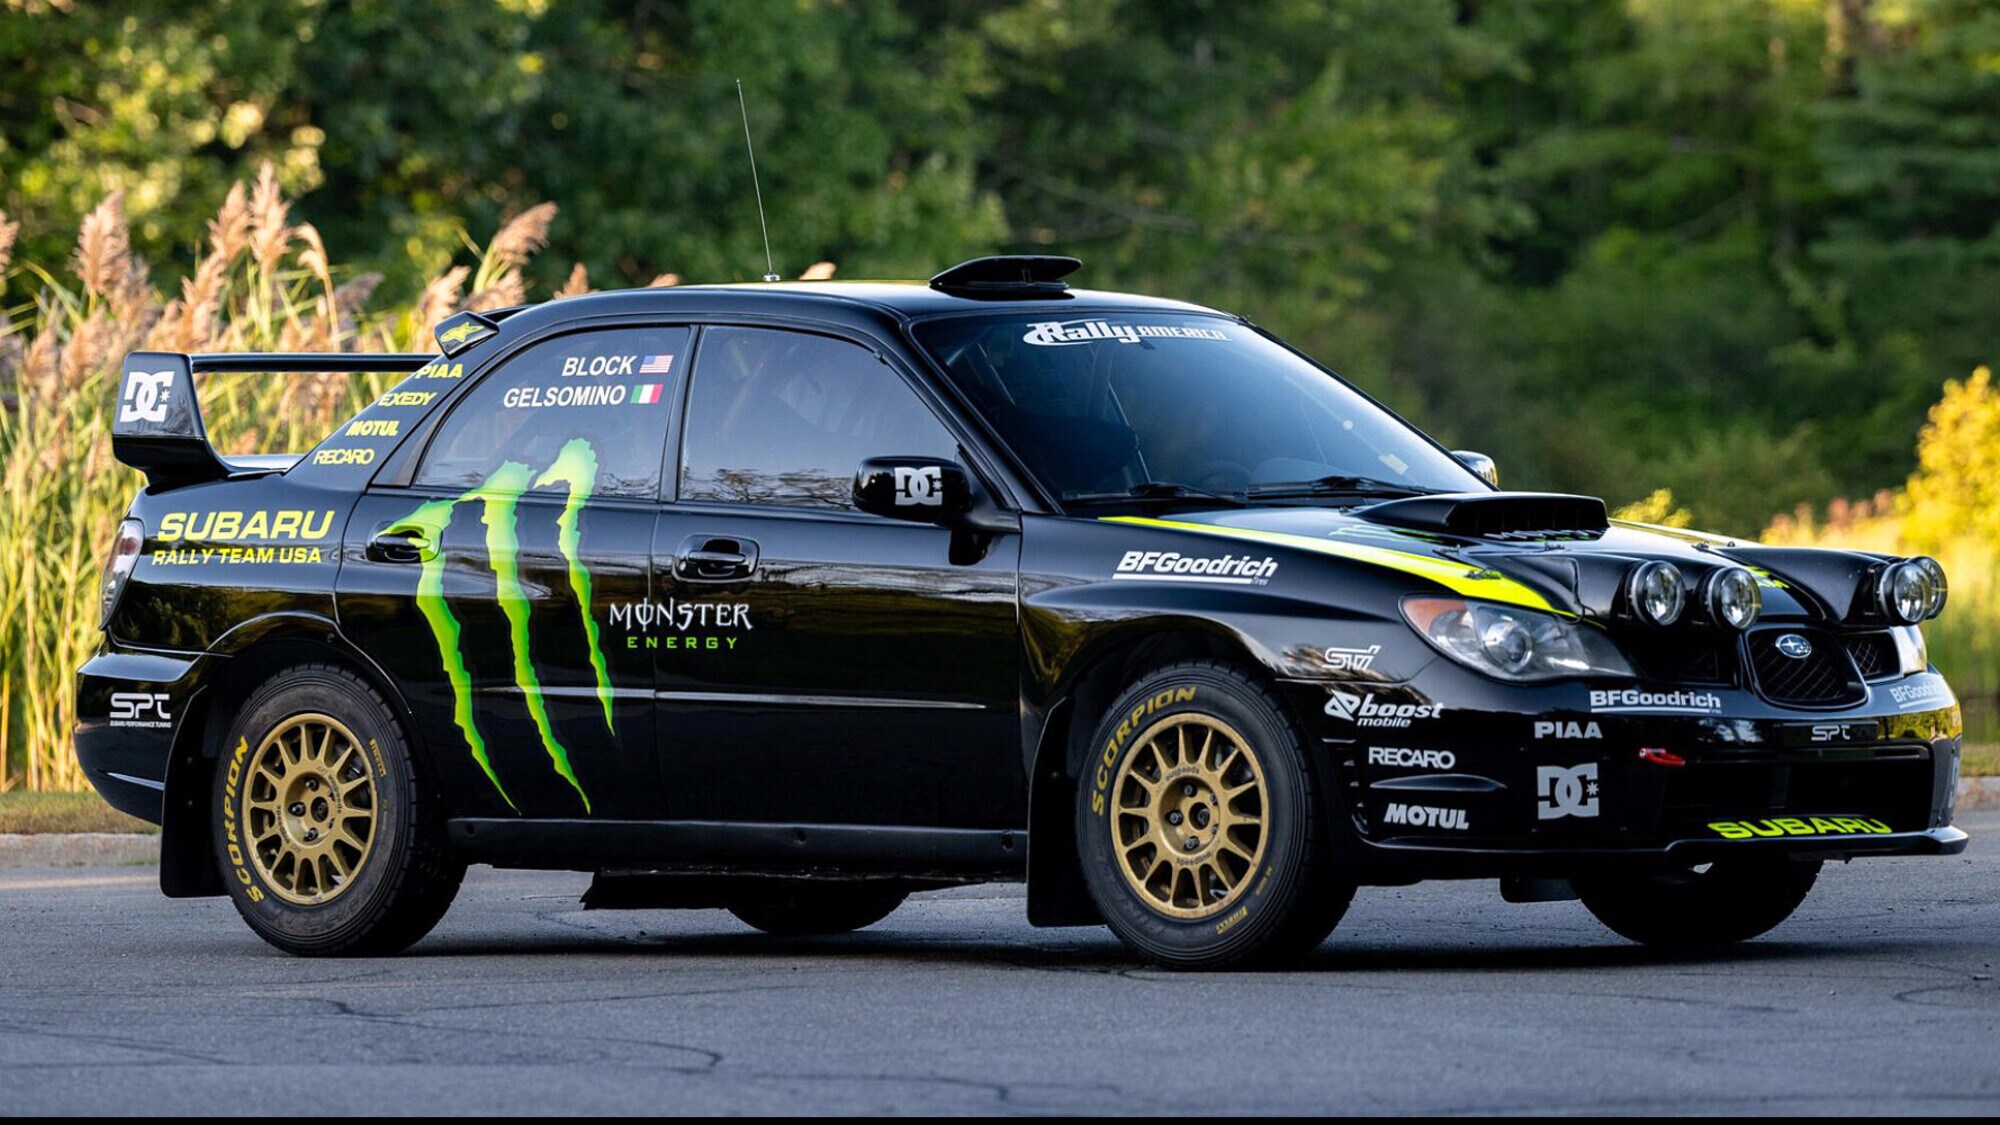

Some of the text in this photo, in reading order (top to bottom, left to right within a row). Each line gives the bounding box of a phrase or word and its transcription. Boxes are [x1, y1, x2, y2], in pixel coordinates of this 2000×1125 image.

[1023, 318, 1141, 347] Rally
[415, 364, 463, 379] PIAA
[561, 355, 638, 376] BLOCK
[120, 371, 174, 423] DC
[378, 392, 437, 407] EXEDY
[503, 385, 626, 408] GELSOMINO
[345, 420, 400, 436] MOTUL
[312, 449, 375, 465] RECARO
[894, 466, 943, 506] DC
[156, 510, 335, 542] SUBARU
[151, 547, 321, 567] RALLY TEAM USA
[1116, 550, 1279, 578] BFGoodrich
[609, 597, 753, 632] MONSTER
[627, 636, 738, 649] ENERGY
[1358, 692, 1444, 719] boost
[1589, 689, 1721, 709] BFGoodrich
[1357, 717, 1412, 728] mobile
[1534, 721, 1602, 739] PIAA
[1091, 686, 1197, 816] SCORPION
[1368, 747, 1456, 769] RECARO
[1537, 762, 1599, 820] DC
[223, 735, 264, 903] SCORPION
[1384, 803, 1470, 830] MOTUL
[1707, 816, 1893, 839] SUBARU
